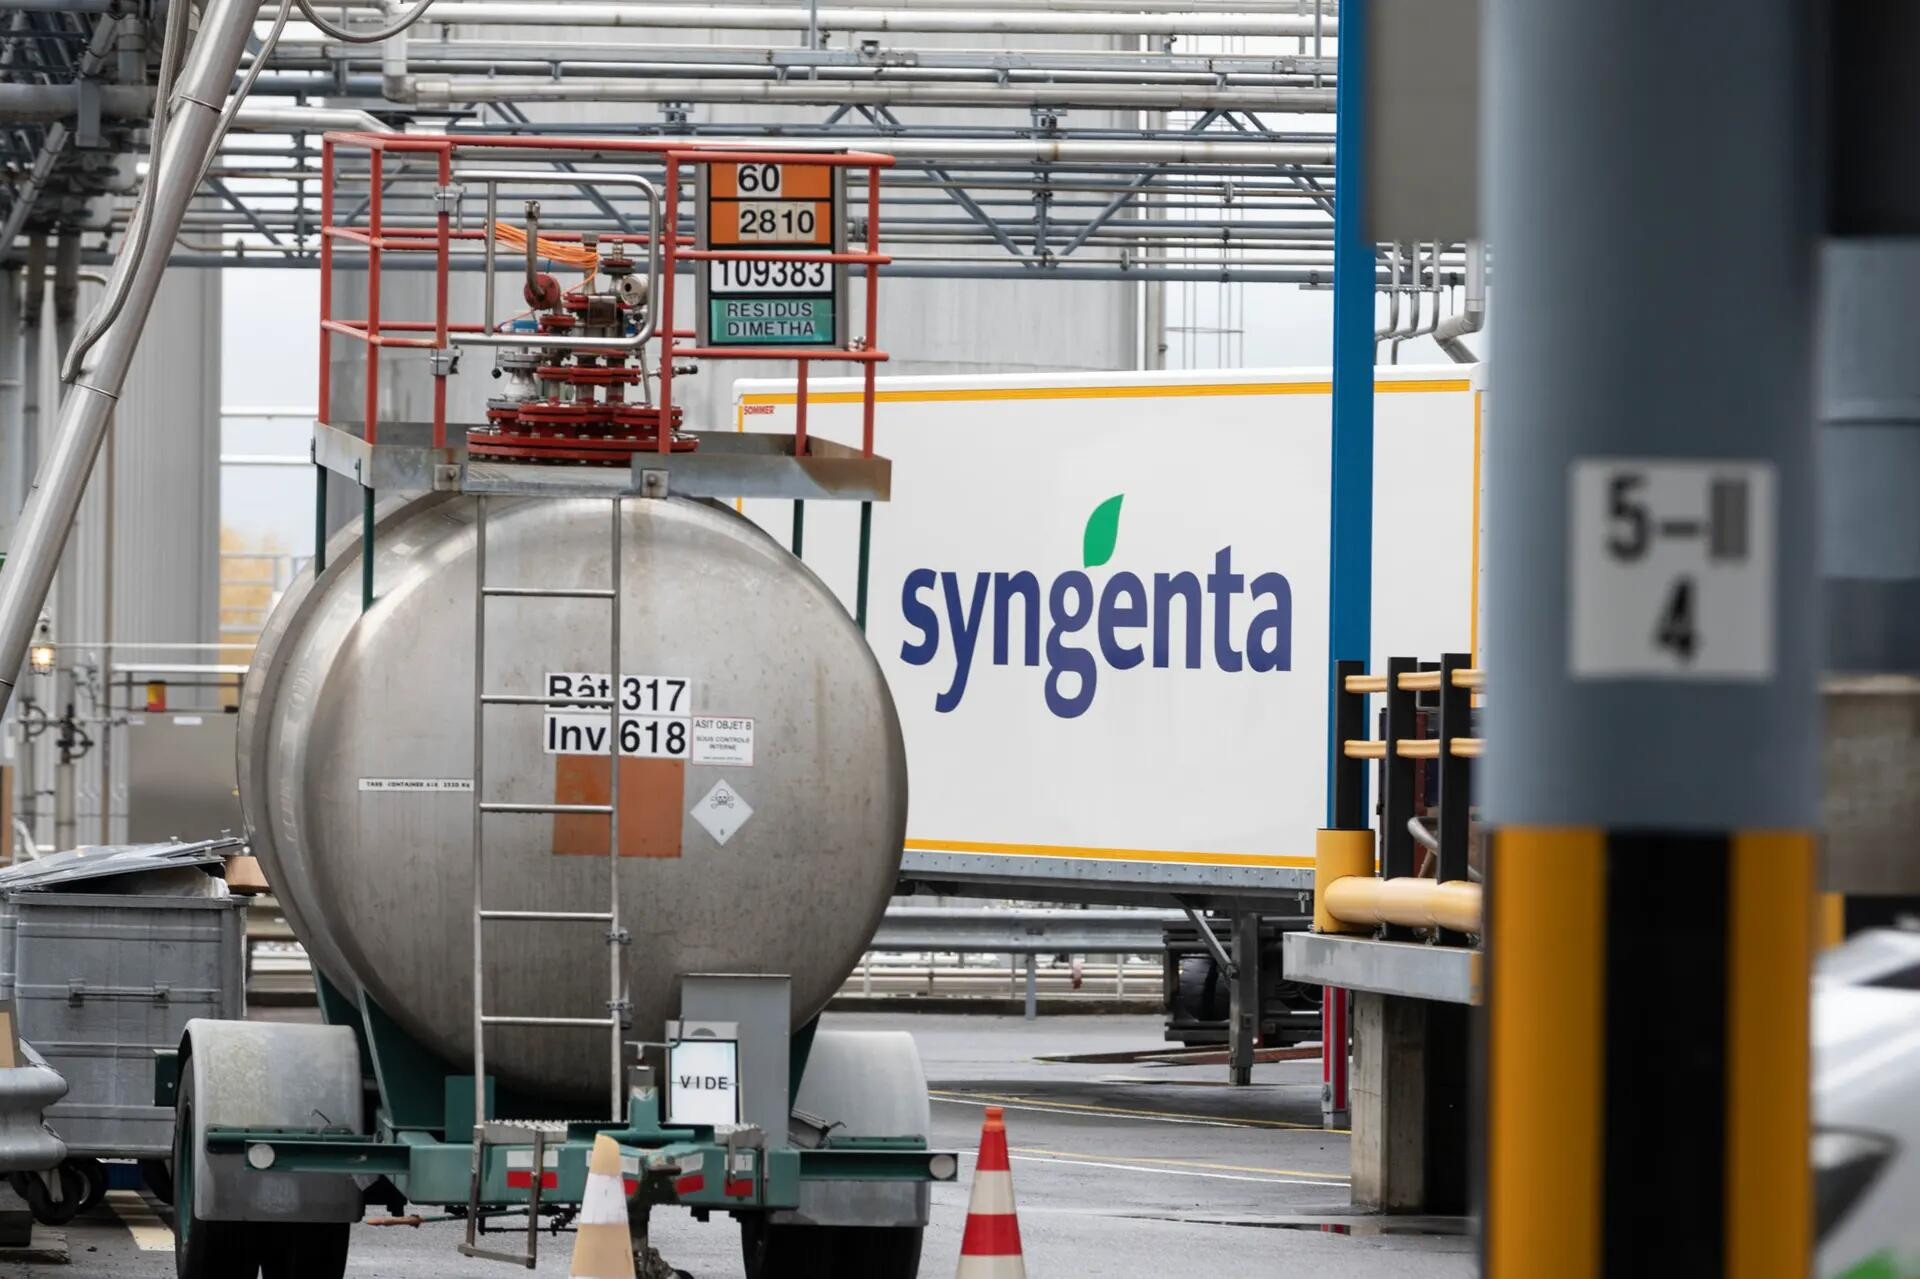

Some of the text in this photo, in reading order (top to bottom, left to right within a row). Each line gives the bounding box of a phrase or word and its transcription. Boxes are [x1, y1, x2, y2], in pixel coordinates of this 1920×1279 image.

[738, 164, 780, 192] 60
[740, 209, 814, 234] 2810
[718, 260, 825, 287] 109383
[727, 303, 813, 317] RESIDUS
[727, 321, 814, 336] DIMETHA
[1655, 572, 1703, 661] 4
[900, 545, 1292, 719] syngenta
[549, 675, 686, 712] Bât 317
[548, 716, 686, 755] Inv 618
[695, 719, 752, 730] ASIT OBJET B
[680, 1075, 729, 1090] VIDE
